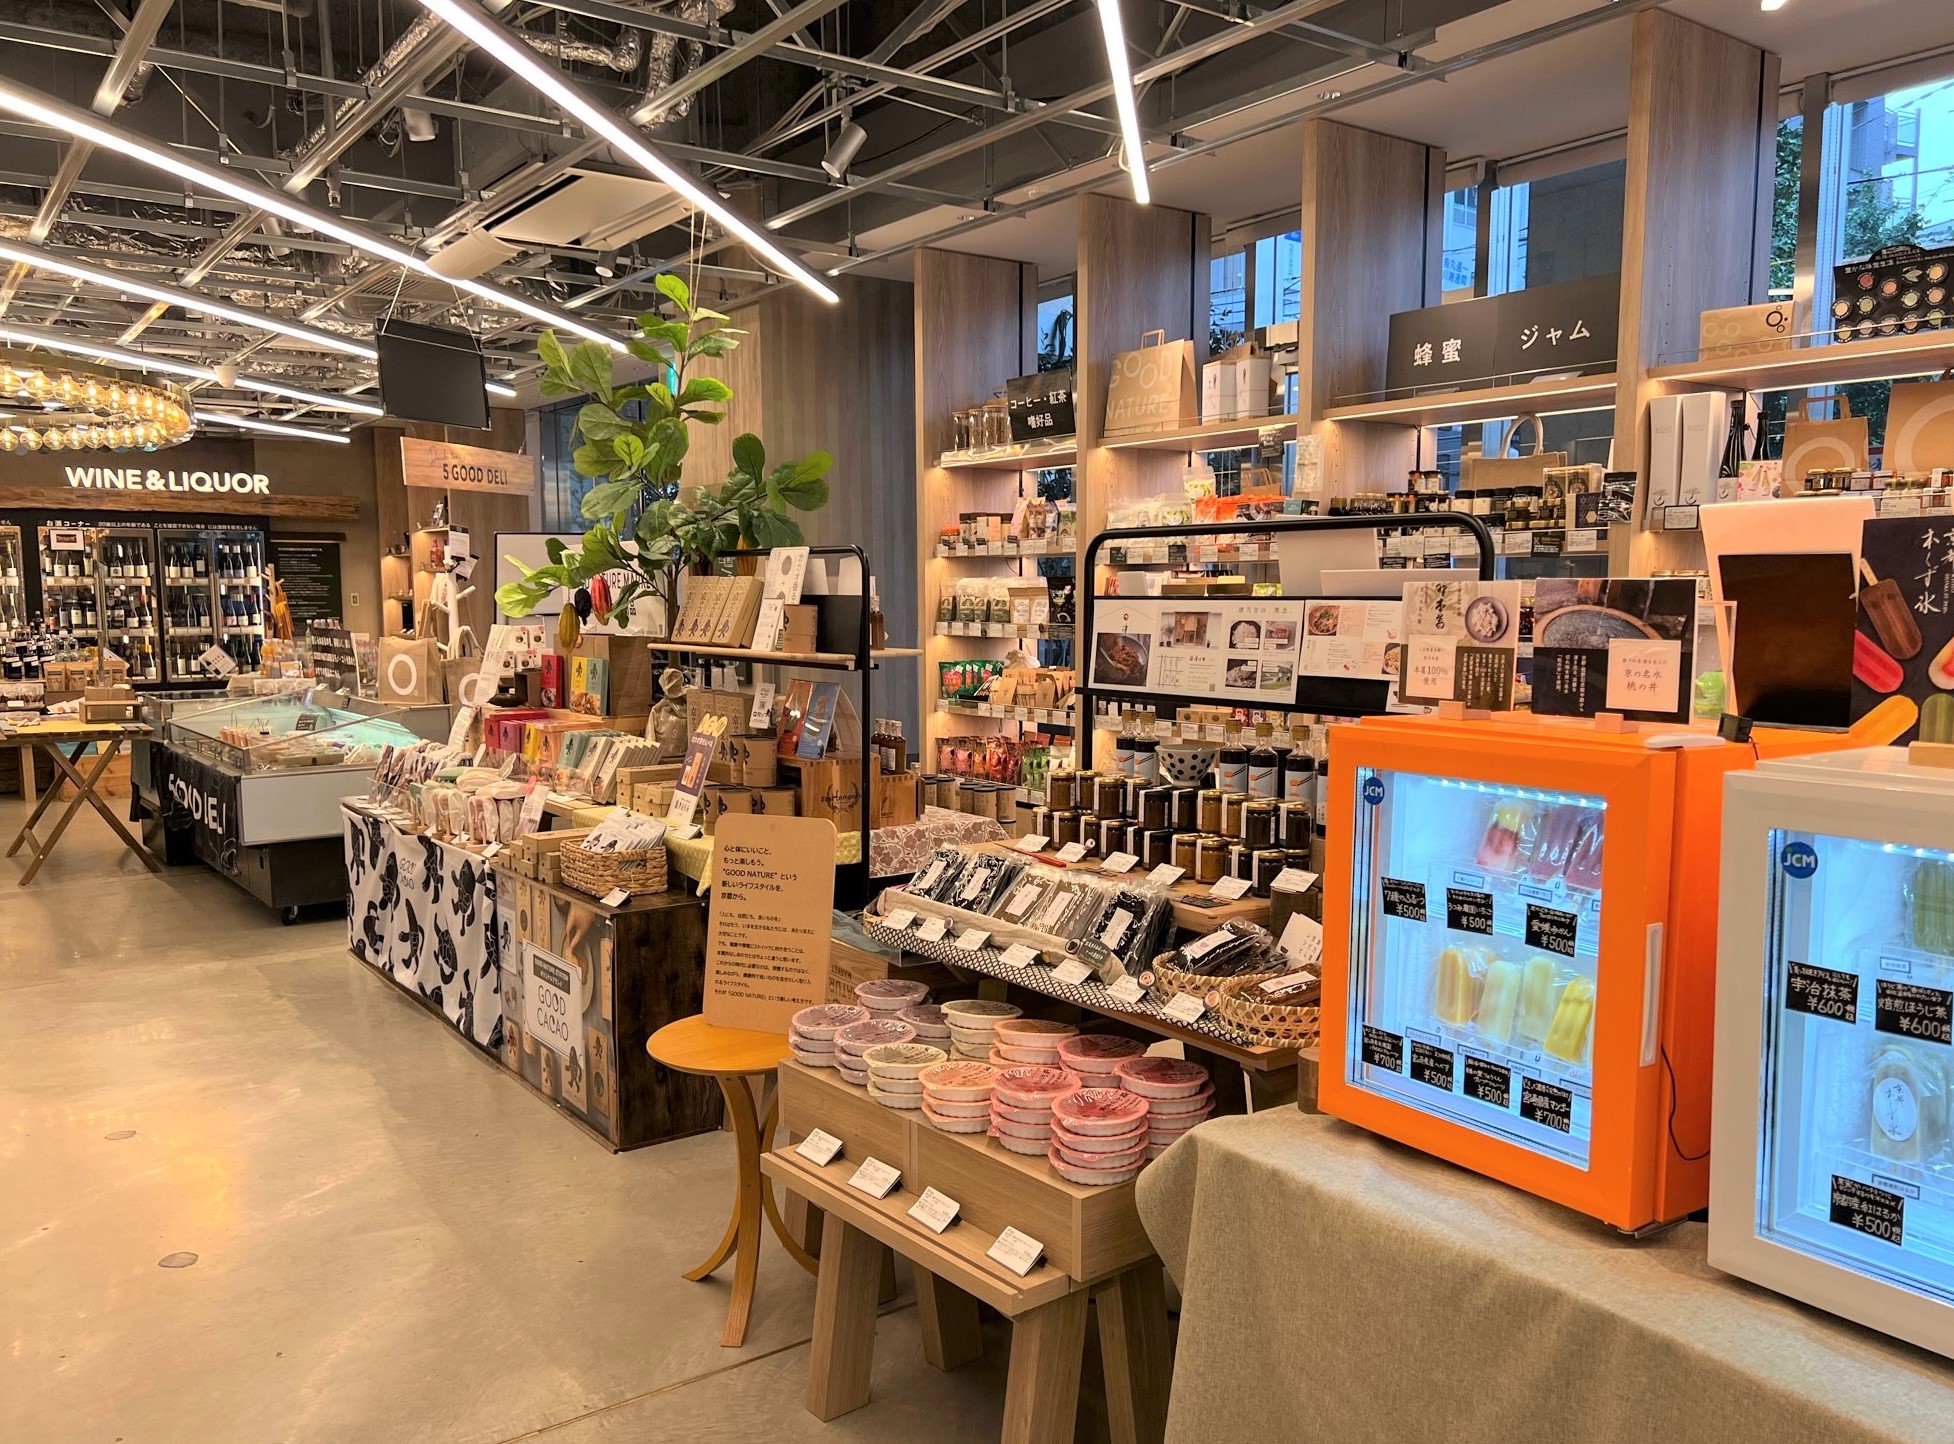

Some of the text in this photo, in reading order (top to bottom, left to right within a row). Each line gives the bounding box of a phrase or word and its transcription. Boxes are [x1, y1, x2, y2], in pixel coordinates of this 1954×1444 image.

[1520, 319, 1591, 350] ジャム
[1413, 338, 1462, 367] 蜂蜜
[1110, 351, 1173, 388] GOOD
[1010, 388, 1068, 409] コーヒー・紅茶
[1027, 412, 1054, 429] 嗜好品
[443, 463, 508, 486] 5 GOOD DELI
[1624, 668, 1662, 679] 京の名水
[1626, 682, 1659, 693] 桃の井
[1364, 786, 1384, 798] JCM
[723, 845, 772, 855] 心と体にいいこと、
[723, 857, 765, 867] もっと楽しもう。
[1783, 853, 1816, 869] JCM
[721, 880, 784, 892] 新しいライフスタイルを、
[720, 892, 747, 901] 京都から。
[1395, 903, 1420, 918] ¥500
[1461, 915, 1486, 930] ¥500
[1531, 919, 1573, 937] 愛媛みかん
[1541, 934, 1569, 953] ¥500
[1790, 976, 1853, 1001] 宇治抹茶
[537, 984, 567, 1017] GOOD
[1807, 995, 1844, 1016] ¥600
[1878, 997, 1948, 1020] 焙煎ほうじ茶
[536, 1007, 570, 1042] CACAO
[1899, 1016, 1941, 1038] ¥600
[1373, 1053, 1396, 1069] ¥700
[1423, 1068, 1447, 1088] ¥500
[1477, 1084, 1502, 1104] ¥500
[1522, 1091, 1570, 1113] 宮崎県産マンゴー
[1534, 1107, 1562, 1129] ¥700
[1851, 1212, 1891, 1239] ¥500
